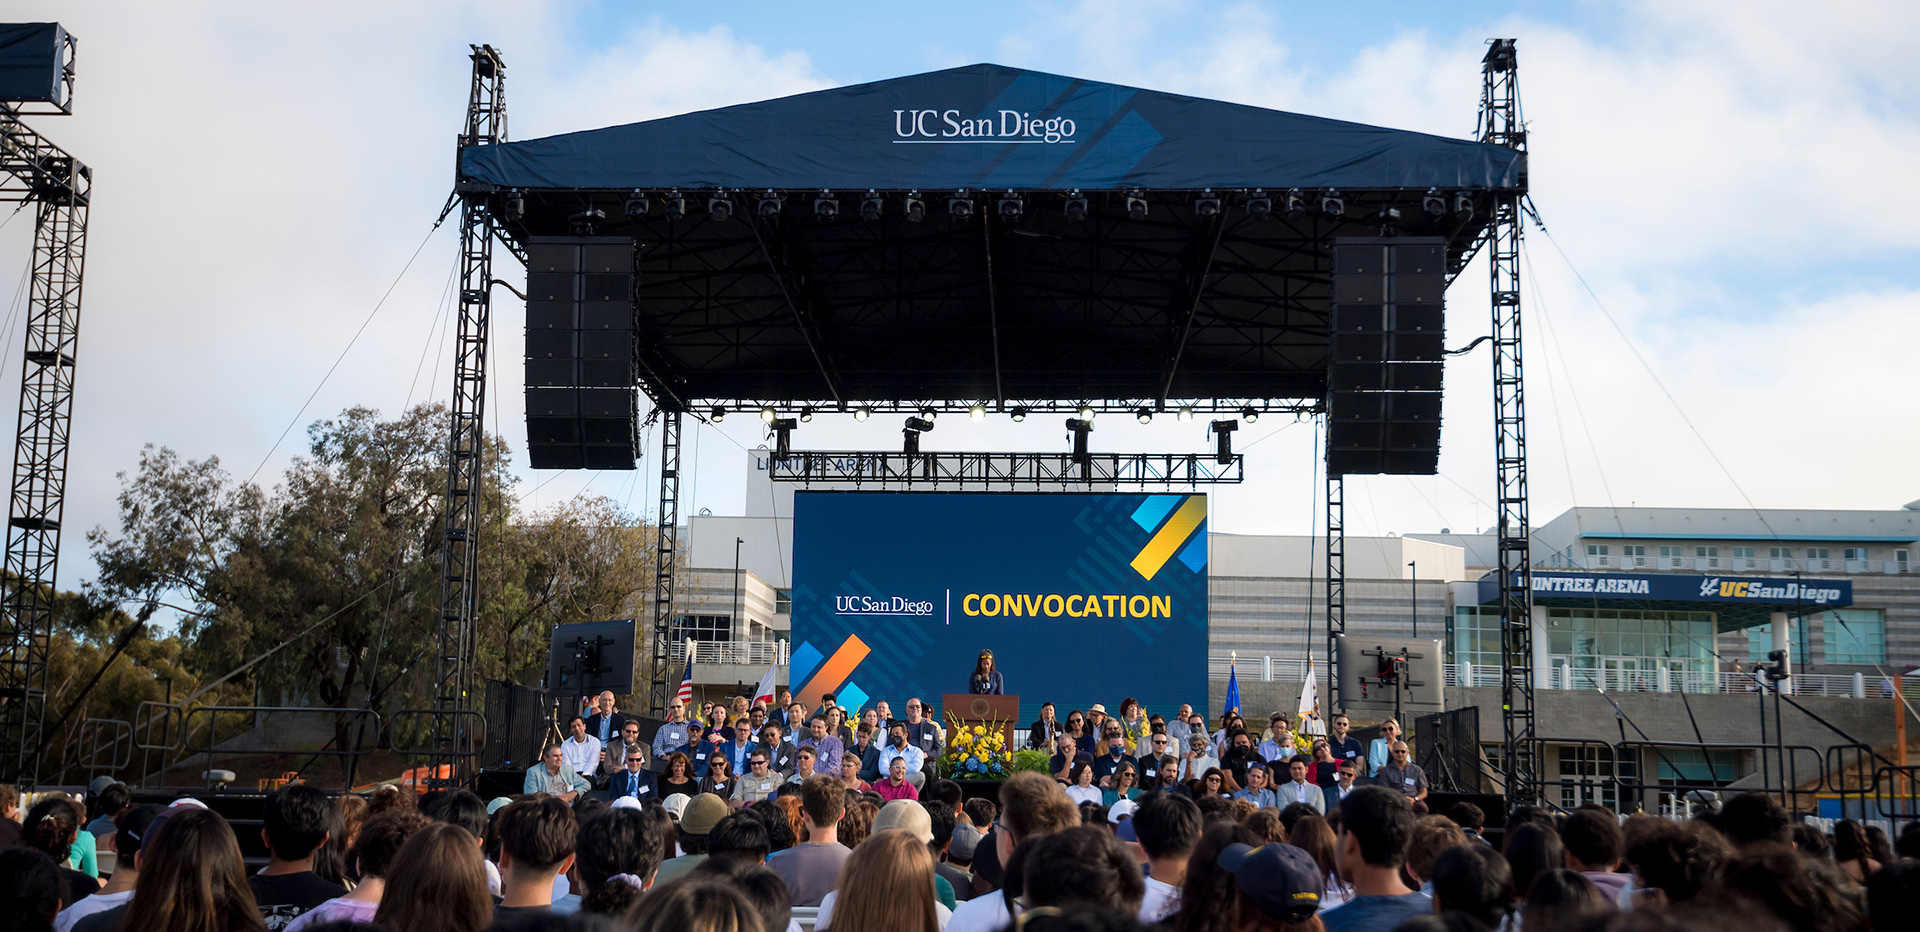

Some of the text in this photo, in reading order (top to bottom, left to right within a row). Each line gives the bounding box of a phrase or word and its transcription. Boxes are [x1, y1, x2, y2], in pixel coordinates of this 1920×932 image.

[893, 109, 1076, 144] UC San Diego
[757, 457, 831, 471] LIONTEE
[1517, 576, 1650, 594] ONTREE ARENA
[835, 595, 934, 616] UC San Diego
[962, 593, 1172, 619] CONVOCATION
